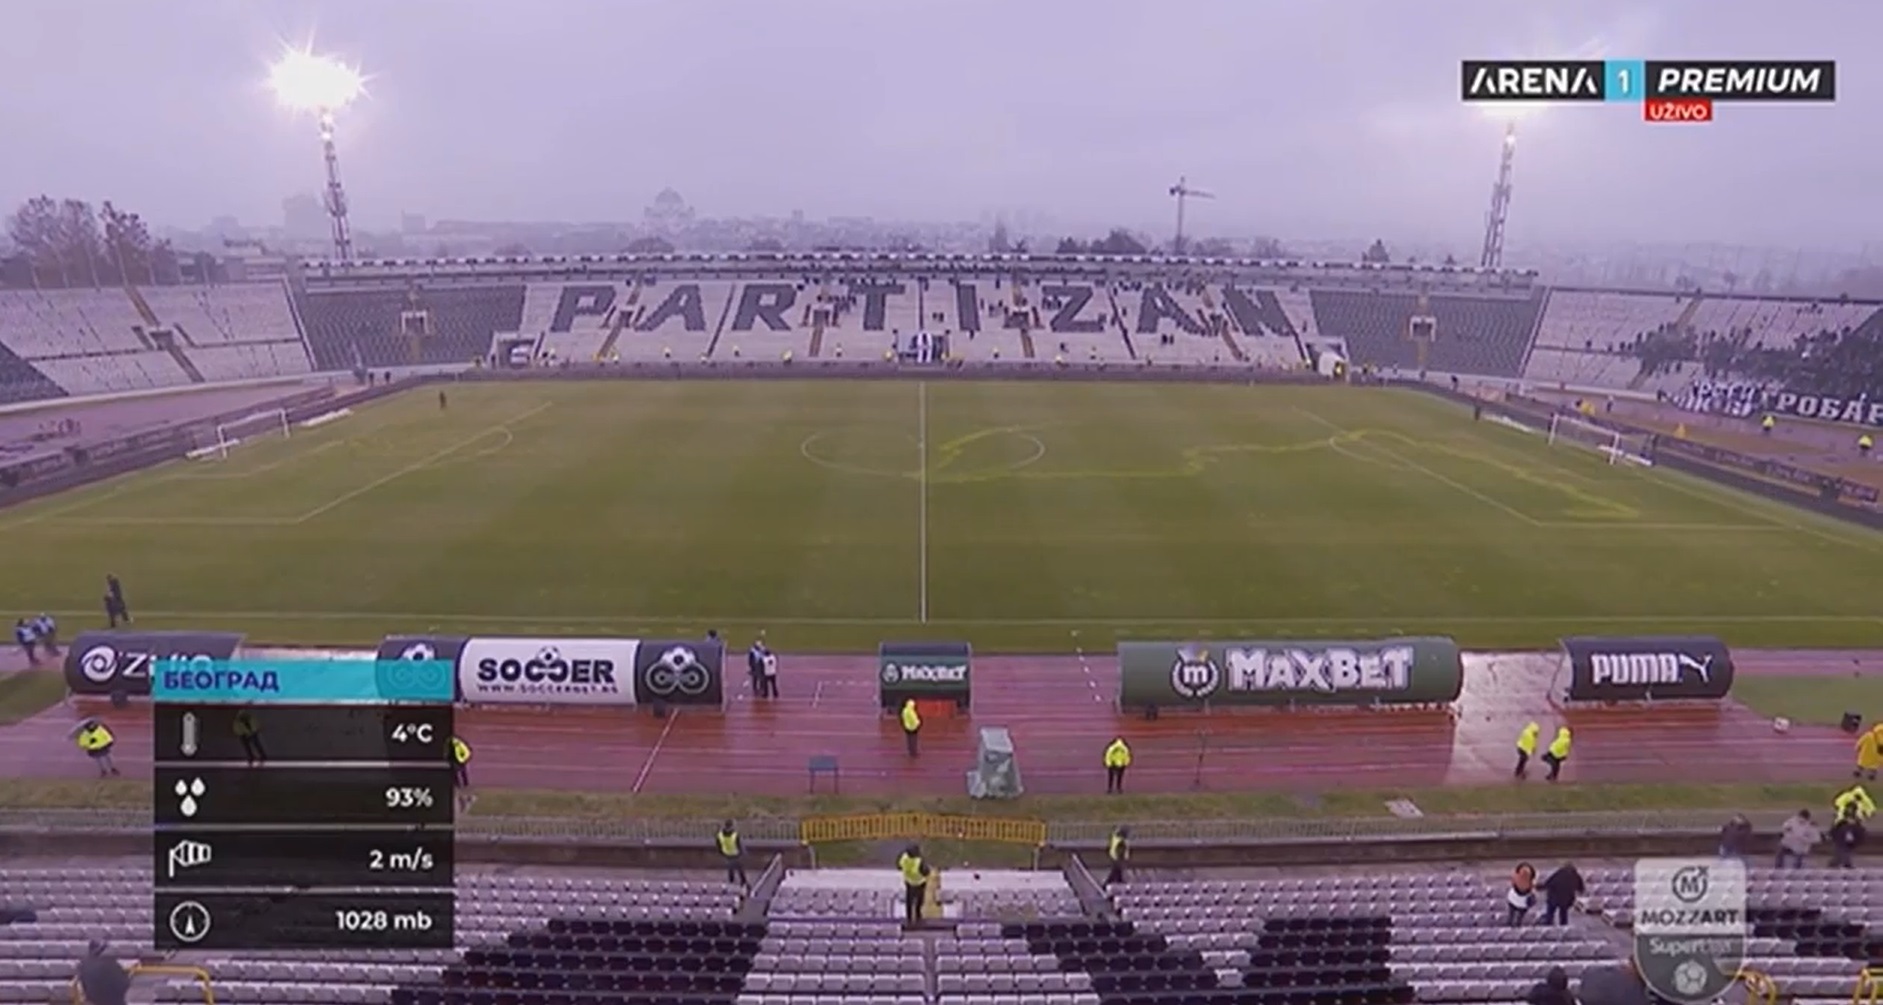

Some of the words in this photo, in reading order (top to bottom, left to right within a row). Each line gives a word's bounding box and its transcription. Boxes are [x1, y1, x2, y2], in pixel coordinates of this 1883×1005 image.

[550, 283, 1298, 337] PARTIZAN
[477, 658, 615, 683] SOCCER
[1591, 653, 1679, 684] PUMA
